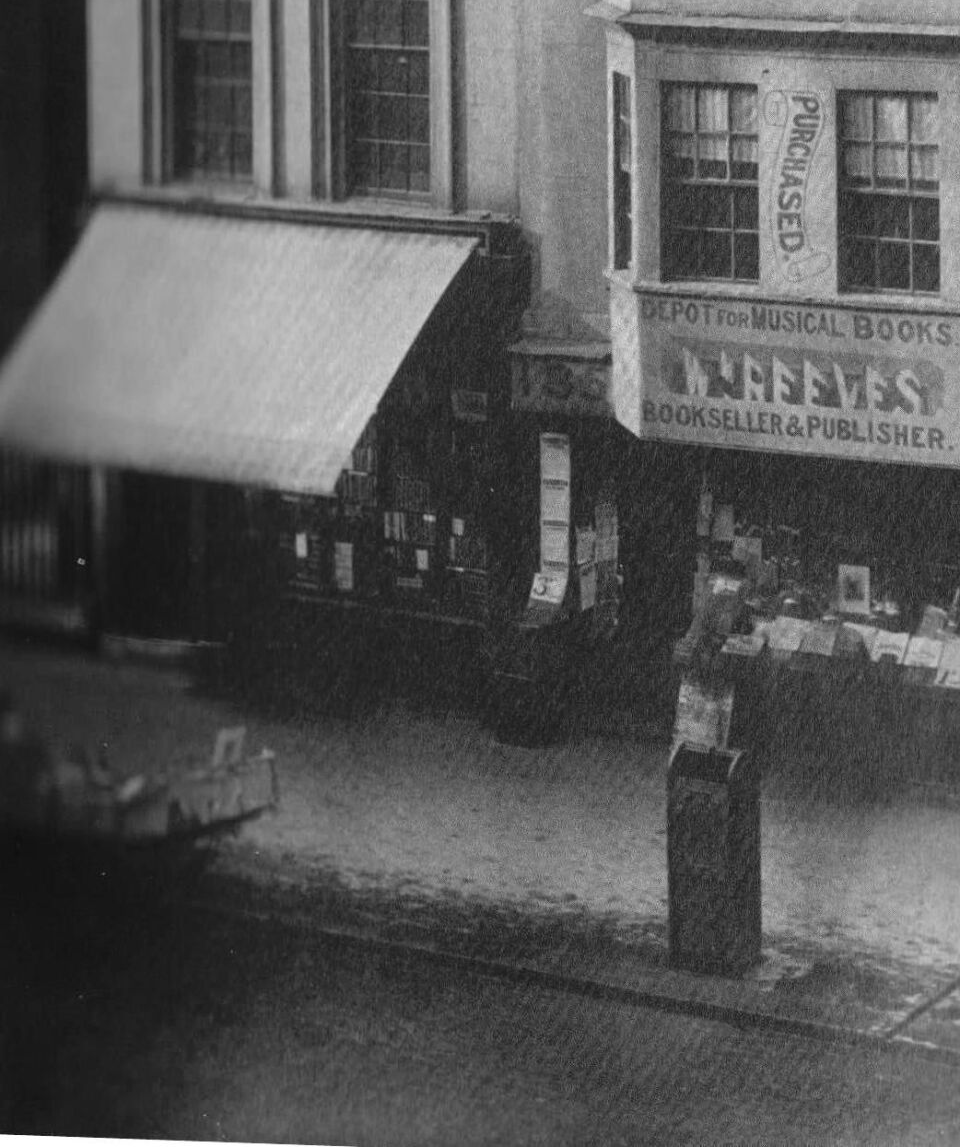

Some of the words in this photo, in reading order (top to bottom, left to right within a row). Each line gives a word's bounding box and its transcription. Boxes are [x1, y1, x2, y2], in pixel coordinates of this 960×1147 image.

[641, 301, 712, 326] DEPOT
[716, 309, 748, 329] FOR
[751, 305, 845, 338] MUSICAL
[642, 403, 783, 436] BOOKSELLER
[785, 413, 806, 438] &
